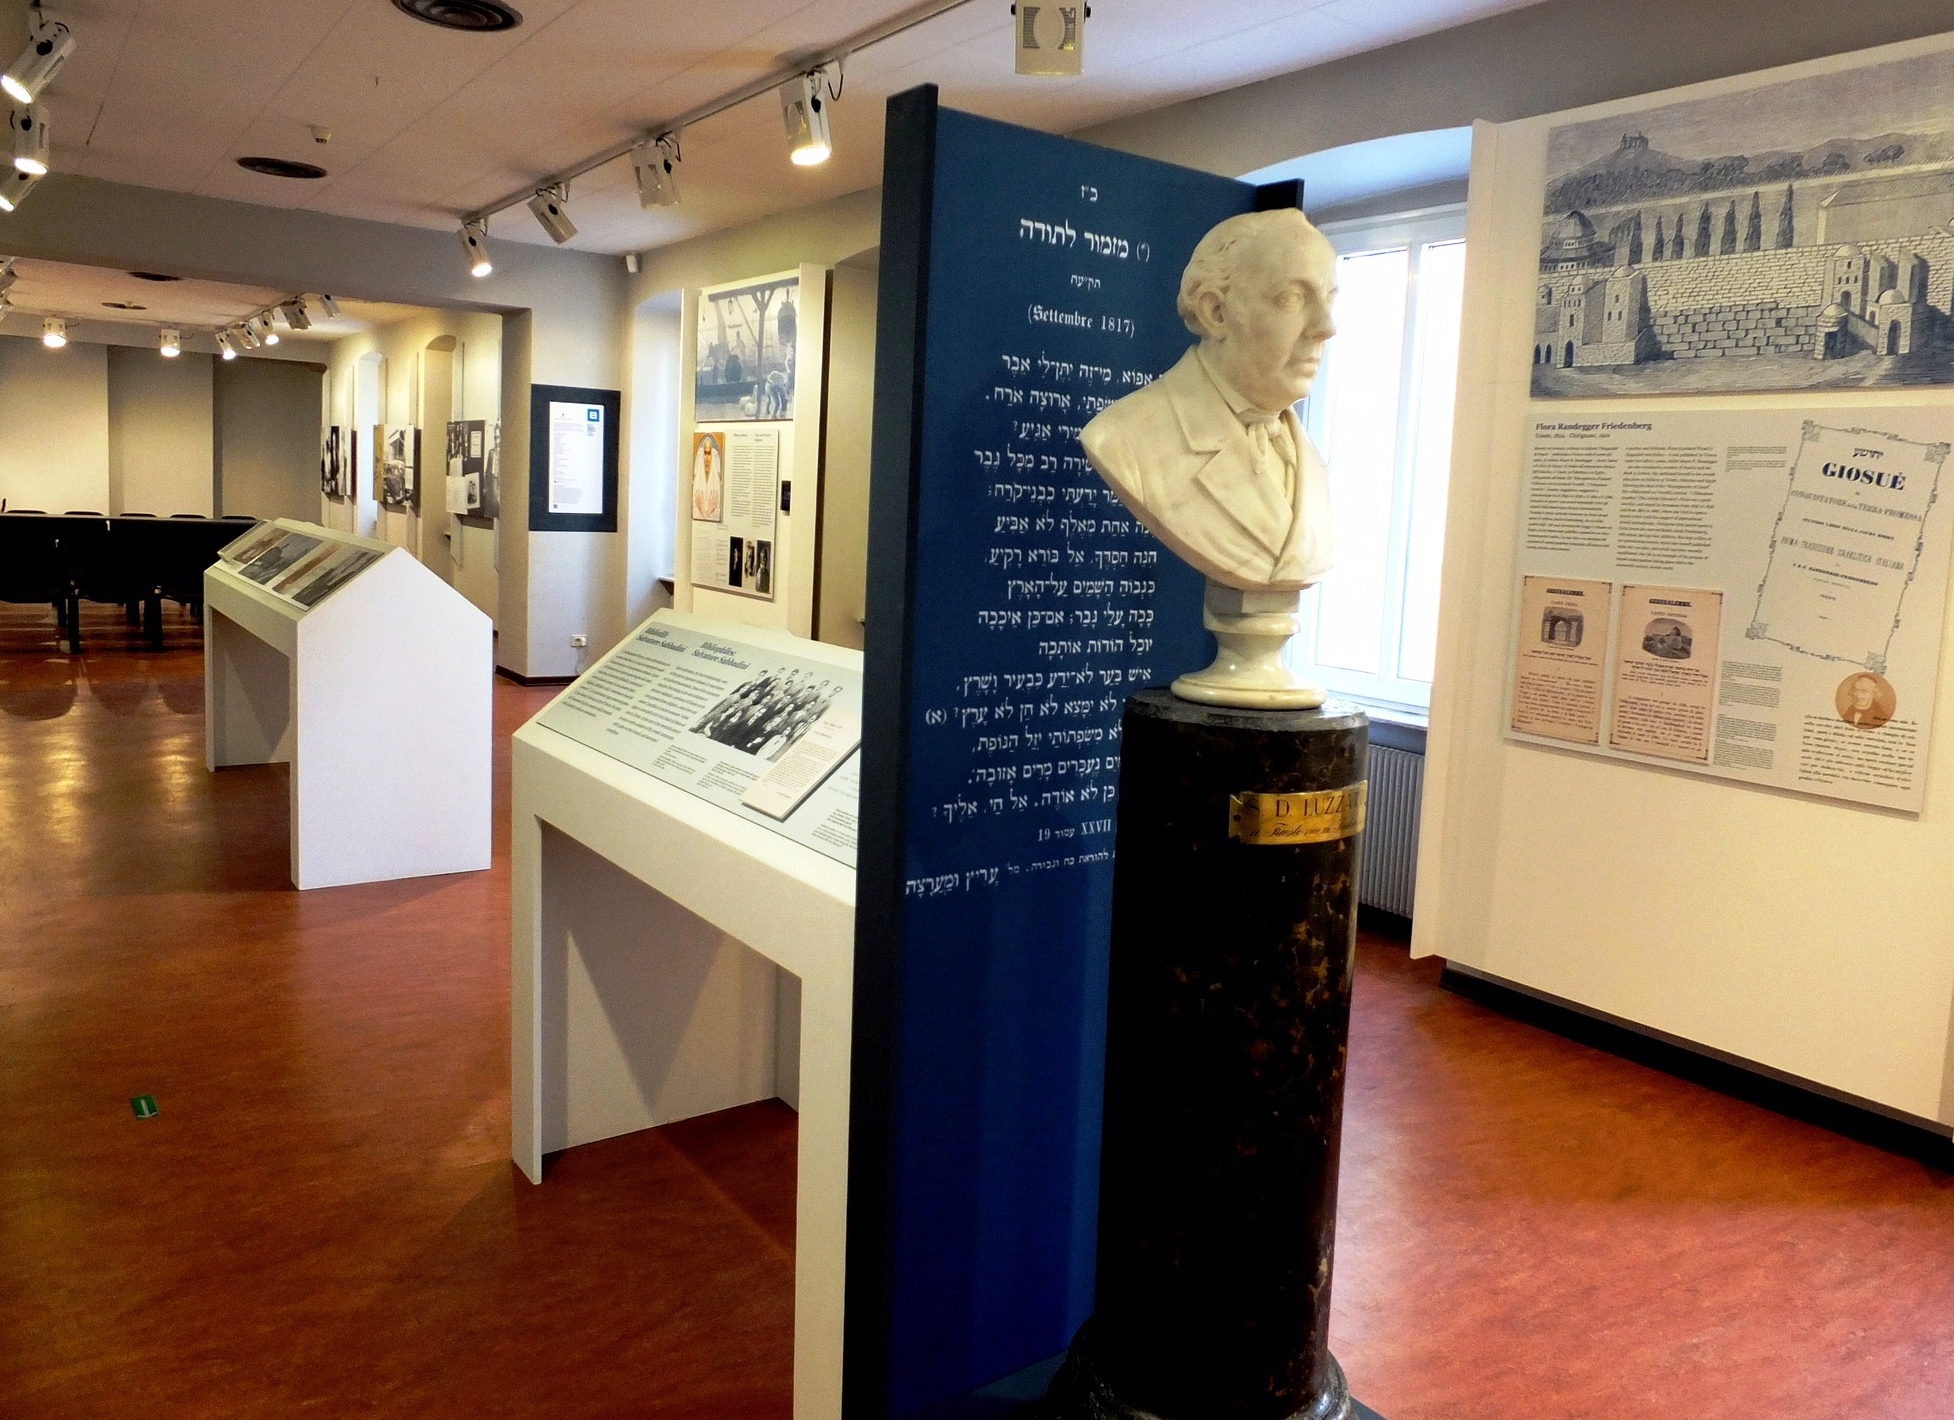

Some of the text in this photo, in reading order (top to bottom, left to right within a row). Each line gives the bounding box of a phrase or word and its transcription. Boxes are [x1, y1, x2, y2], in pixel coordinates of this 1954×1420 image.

[1019, 218, 1077, 248] לתודה
[1083, 230, 1130, 258] מזמור
[1027, 303, 1135, 339] (Settembre 1817)
[1535, 421, 1653, 433] Flora Randegger Friedenberg
[925, 708, 947, 725] (א)
[1275, 799, 1292, 818] D.
[1037, 827, 1051, 842] 19
[1080, 818, 1112, 835] XXVII
